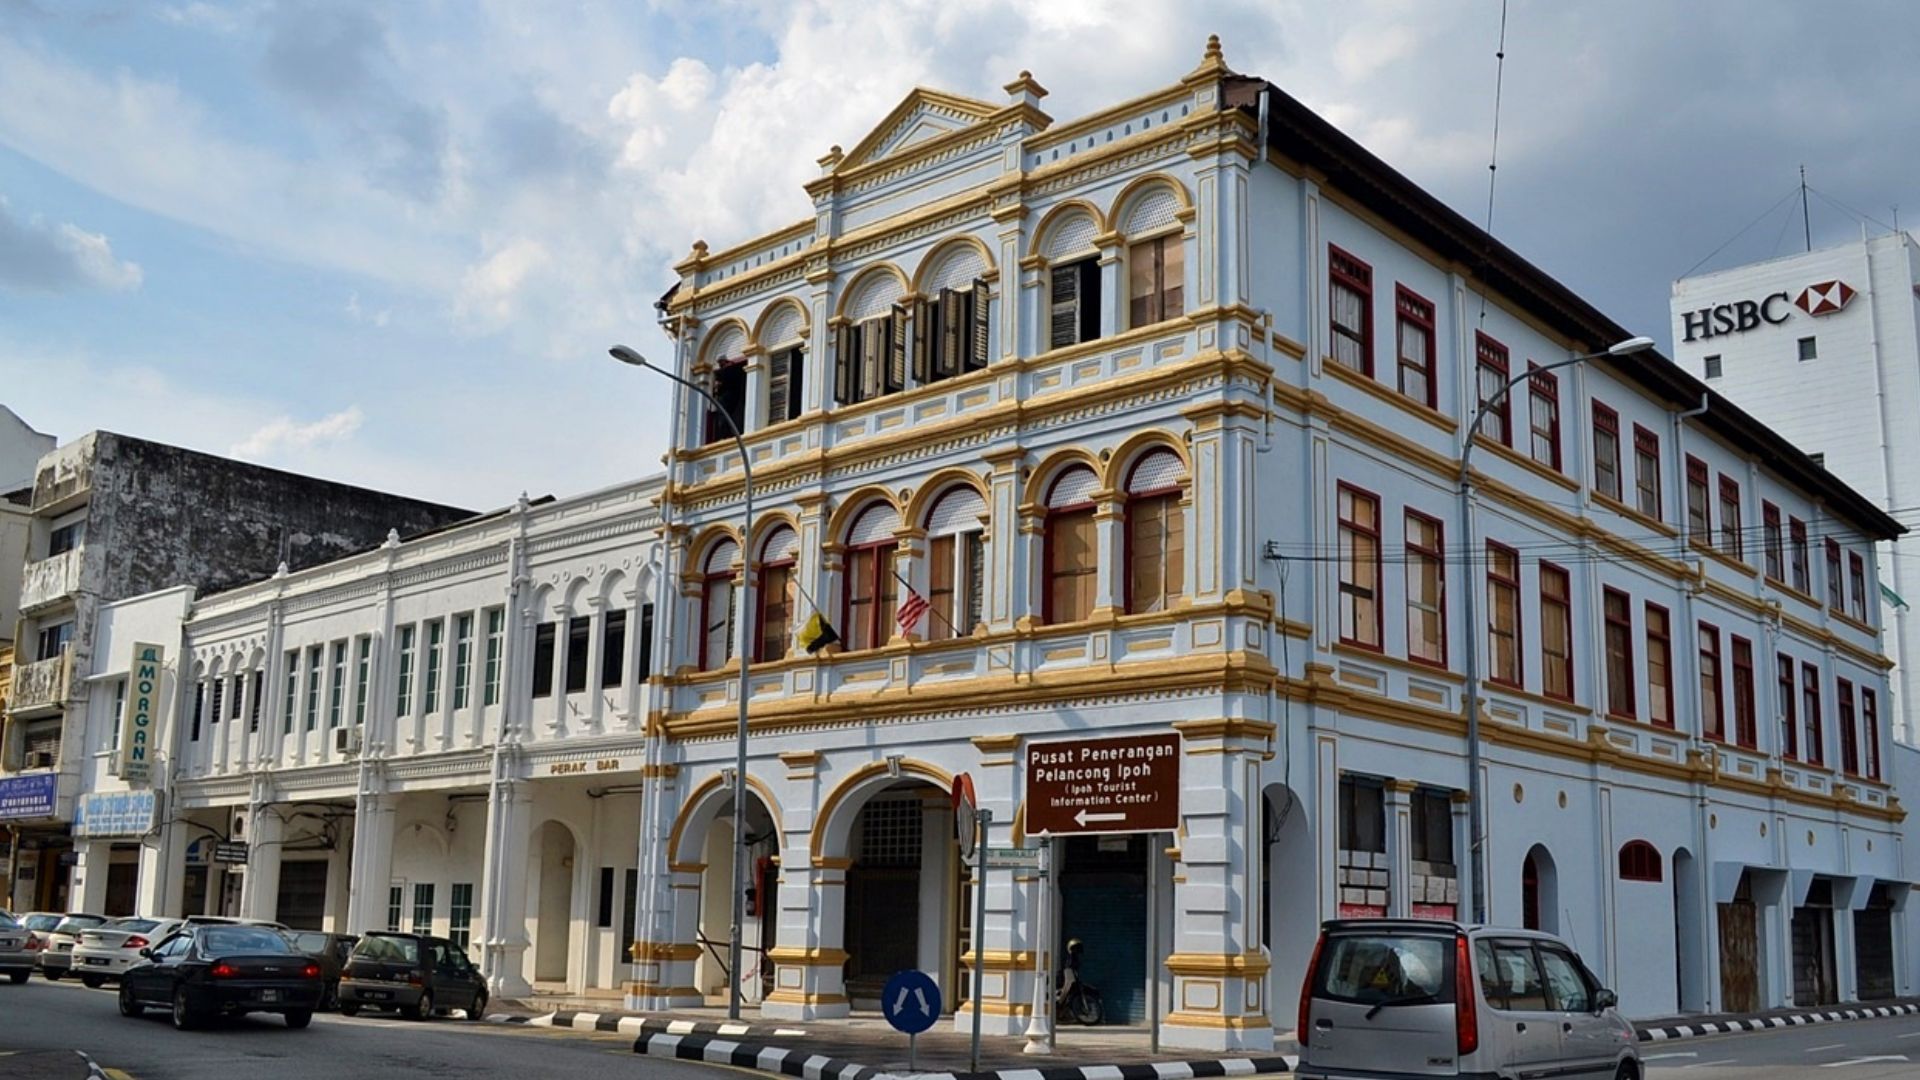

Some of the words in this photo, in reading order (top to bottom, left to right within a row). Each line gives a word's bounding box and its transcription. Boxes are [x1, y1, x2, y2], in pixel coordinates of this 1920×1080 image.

[1681, 292, 1790, 342] HSBC
[132, 665, 154, 760] MORGAN
[1031, 750, 1073, 765] Pusat
[1081, 745, 1173, 761] Penerangan
[550, 762, 587, 775] PERAK
[597, 759, 619, 771] BAR
[1036, 767, 1110, 782] Pelancong
[1118, 763, 1151, 780] Ipoh
[1098, 781, 1136, 793] Tourist
[1050, 796, 1111, 807] Information
